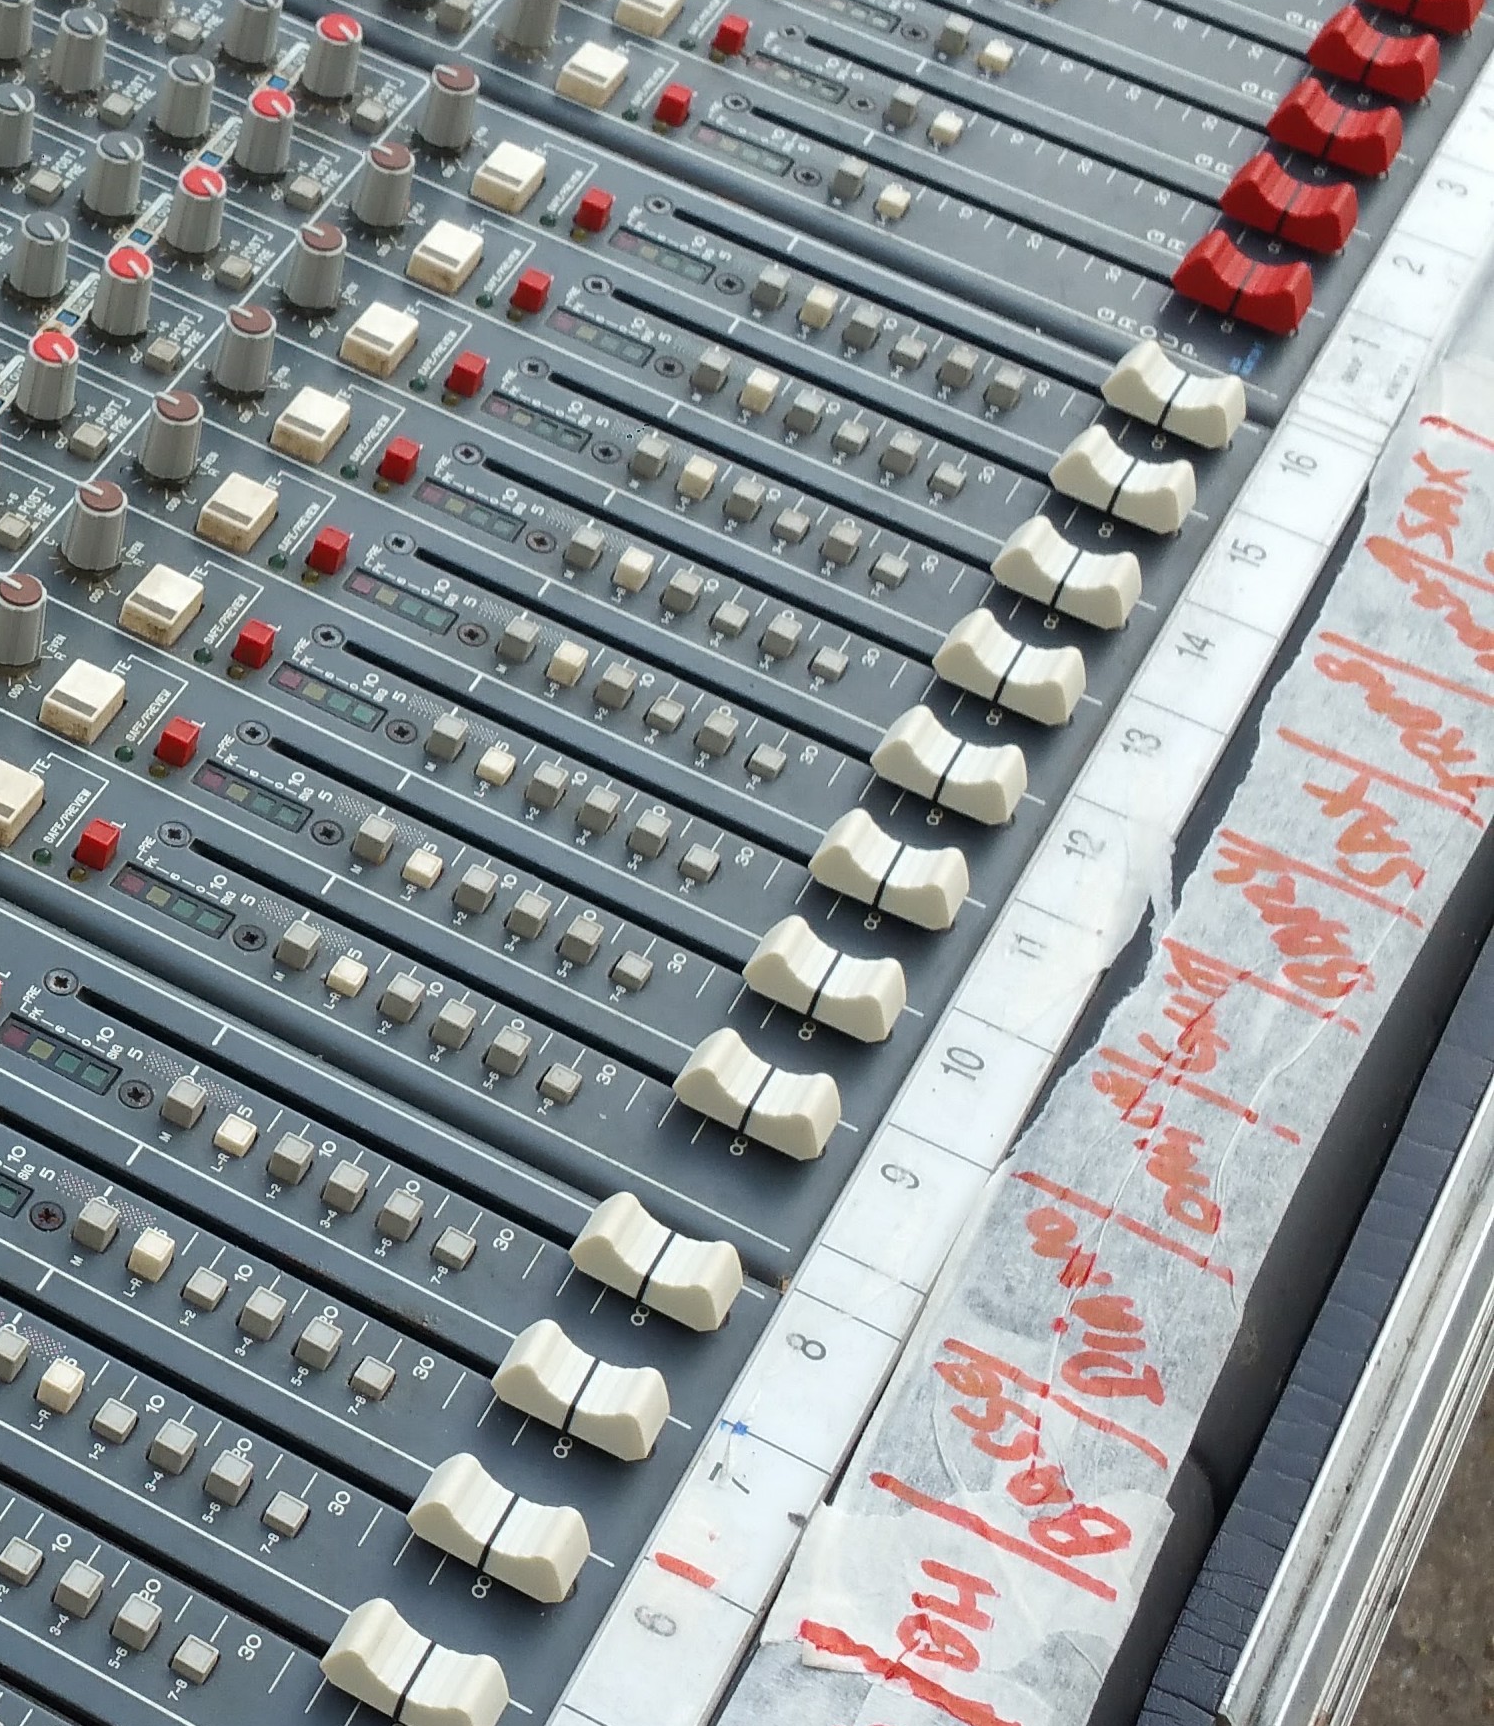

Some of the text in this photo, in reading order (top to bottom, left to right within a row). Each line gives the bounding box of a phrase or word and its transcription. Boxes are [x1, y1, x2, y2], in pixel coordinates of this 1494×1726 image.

[1437, 179, 1468, 197] 3
[1392, 255, 1425, 275] 2
[1032, 377, 1051, 398] 30
[1278, 449, 1320, 478] 16
[1226, 537, 1269, 568] 15
[920, 555, 939, 574] 30
[1175, 631, 1218, 660] 14
[1120, 727, 1163, 757] 13
[735, 846, 754, 865] 30
[1063, 829, 1108, 860] 12
[667, 952, 687, 973] 30
[940, 1045, 986, 1085] 10
[320, 1140, 337, 1157] 10
[880, 1163, 922, 1191] 9
[493, 1229, 515, 1251] 30
[234, 1264, 254, 1283] 10
[786, 1333, 827, 1362] 8
[413, 1355, 436, 1381] 30
[145, 1394, 166, 1414] 10
[347, 1394, 367, 1415] 7-8
[328, 1490, 351, 1516] 30
[51, 1532, 72, 1554] 10
[260, 1532, 280, 1554] 7-8
[635, 1604, 676, 1638] 6
[239, 1633, 263, 1661] 30
[168, 1679, 188, 1702] 7-8
